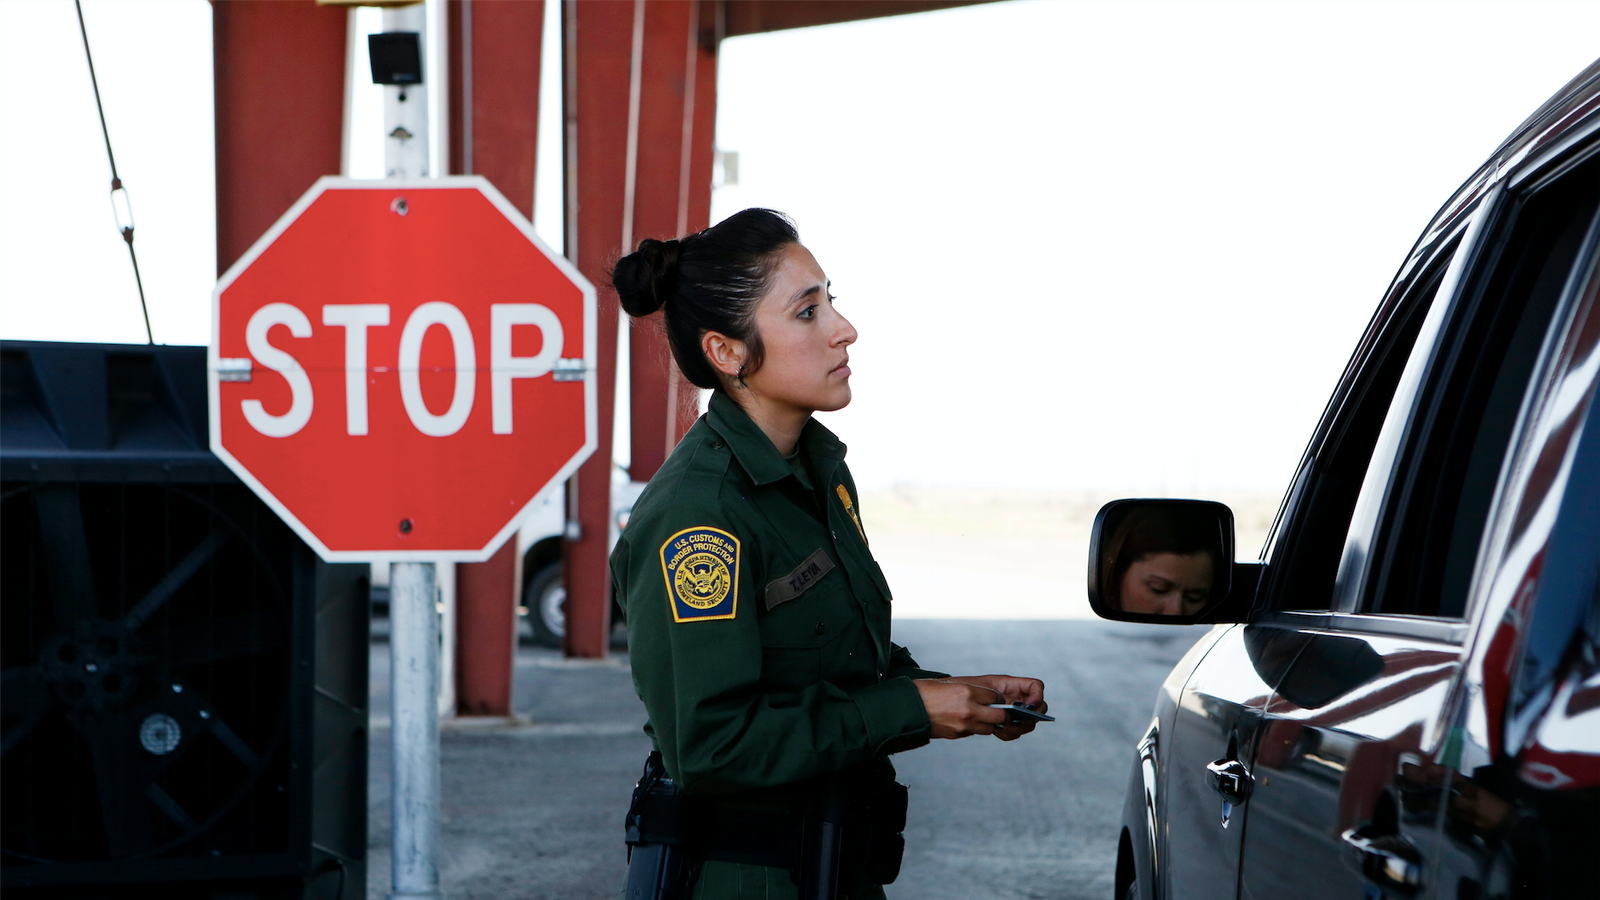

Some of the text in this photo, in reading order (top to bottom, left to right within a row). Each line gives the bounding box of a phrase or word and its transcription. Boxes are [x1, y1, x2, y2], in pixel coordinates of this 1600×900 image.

[241, 301, 564, 438] STOP
[668, 543, 735, 570] BORDER PROTECTION
[674, 534, 735, 553] U.S. CUSTOMS AND
[797, 562, 822, 586] LEYVA
[677, 580, 729, 607] HOMELAND SECURITY
